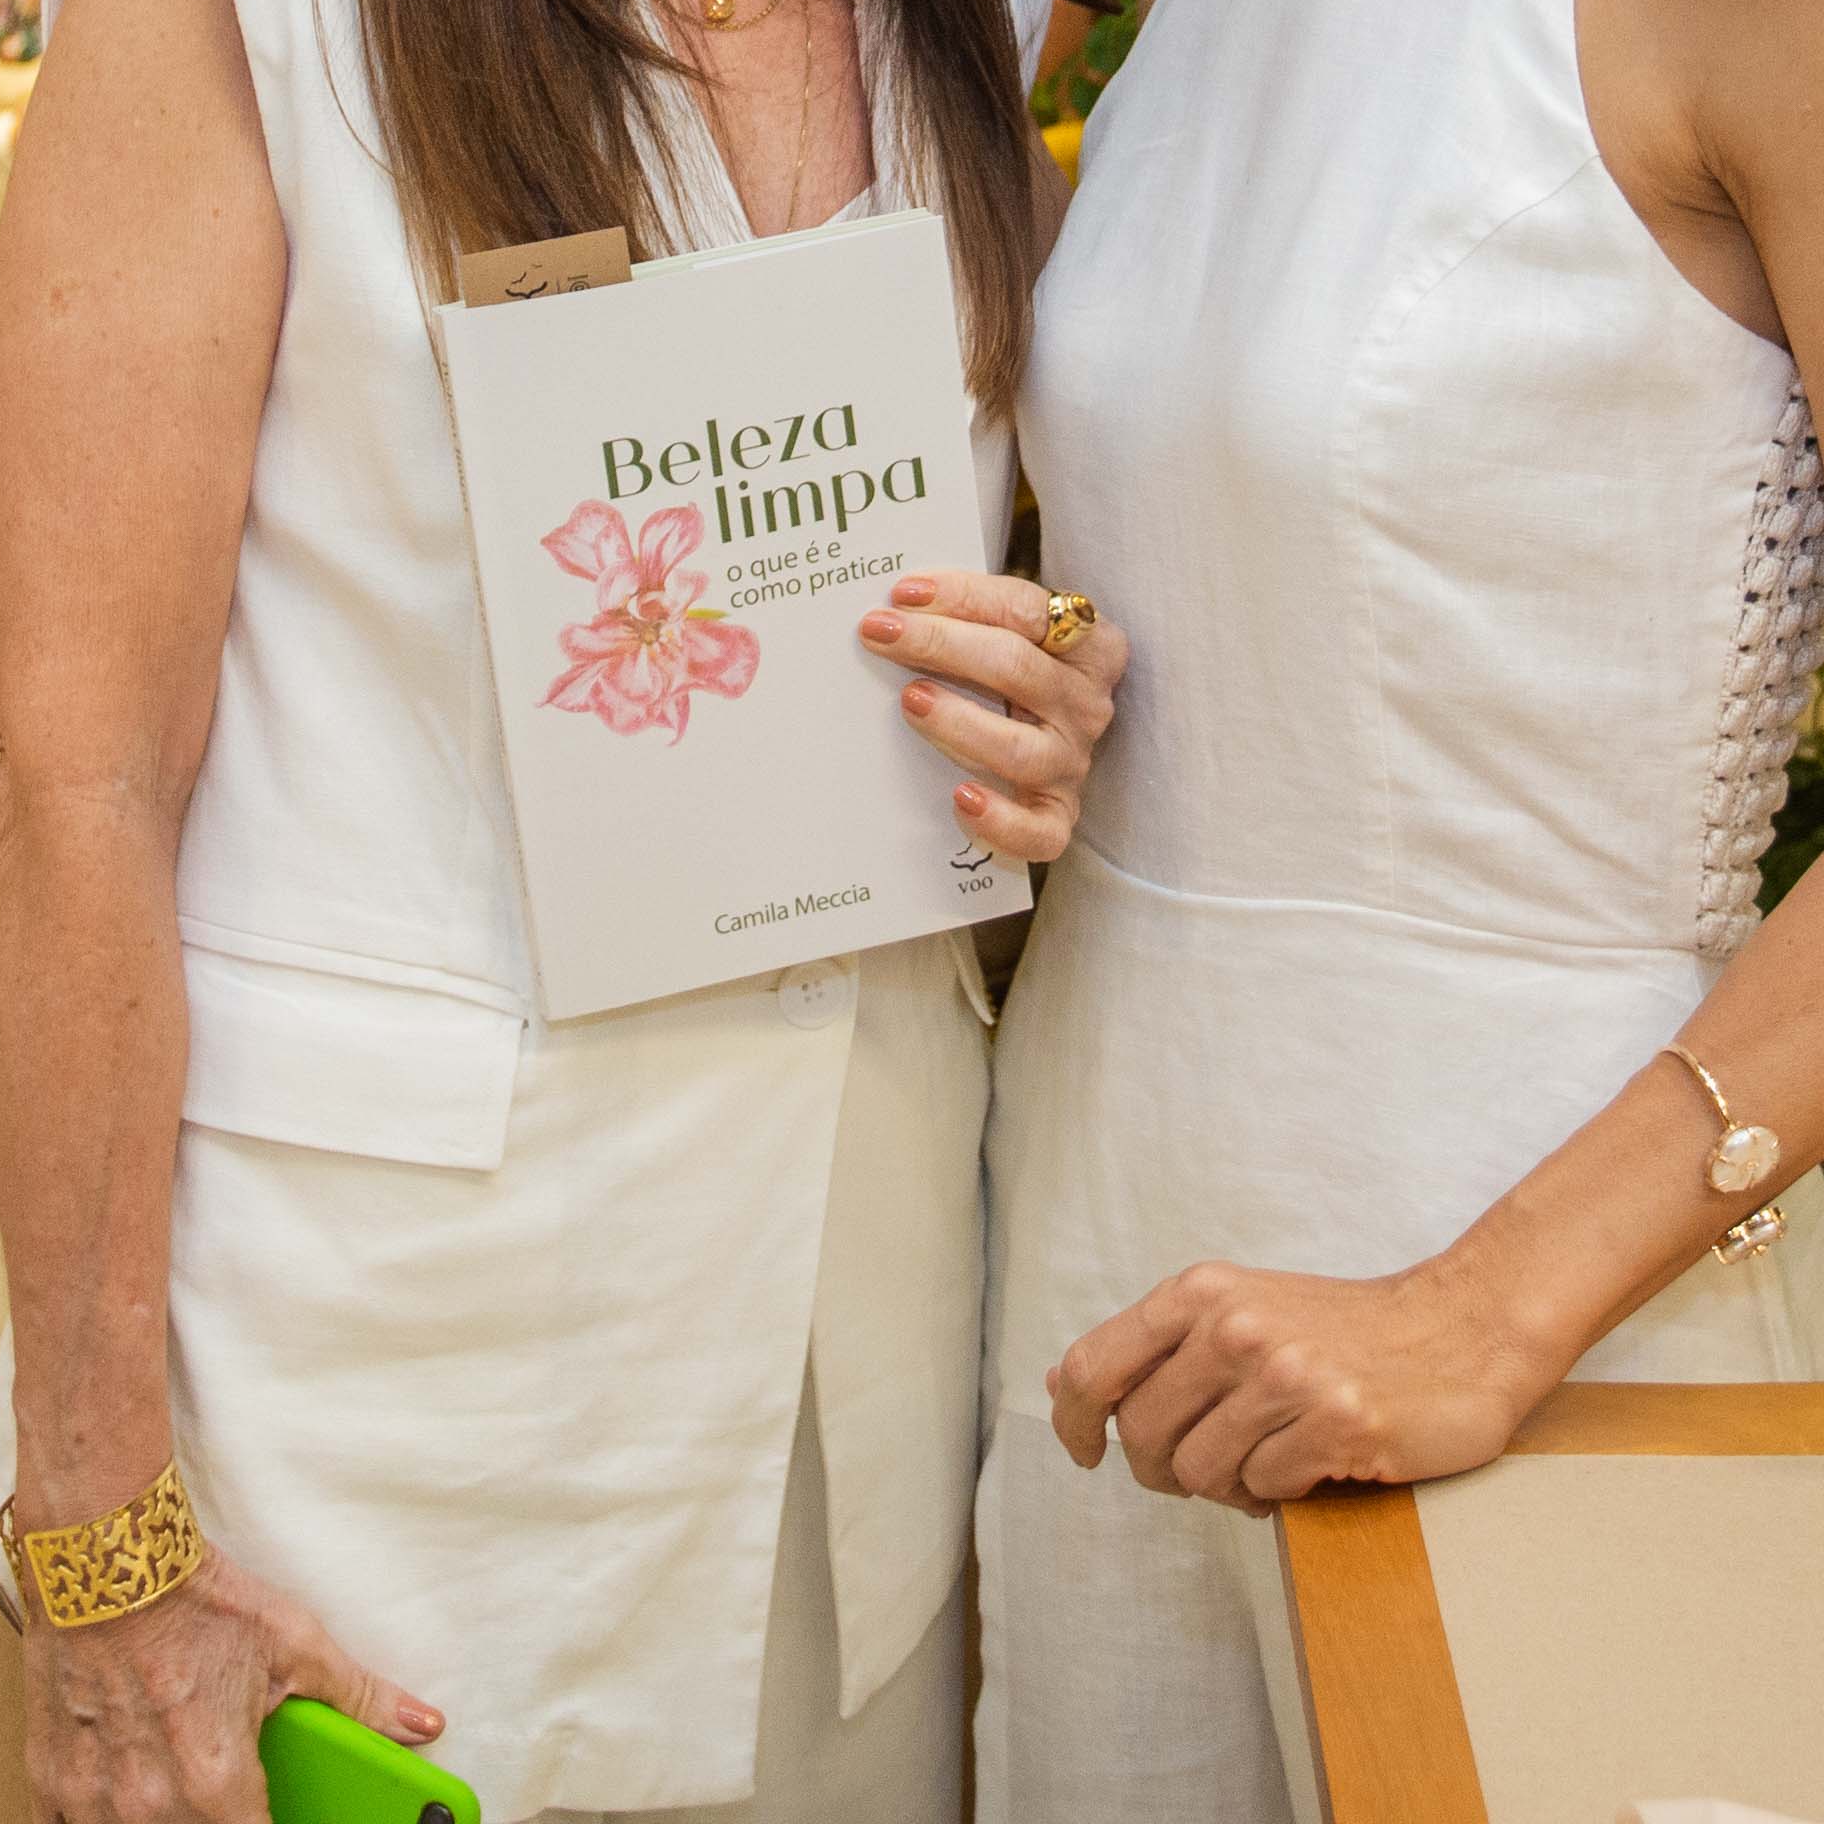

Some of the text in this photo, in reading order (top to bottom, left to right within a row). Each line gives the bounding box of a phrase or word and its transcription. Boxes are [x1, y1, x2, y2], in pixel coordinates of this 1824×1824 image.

[602, 403, 857, 500] Beleza
[715, 456, 926, 544] limpa
[727, 540, 842, 583] o que é e
[729, 551, 905, 610] como praticar
[714, 883, 872, 935] Camila Meccia
